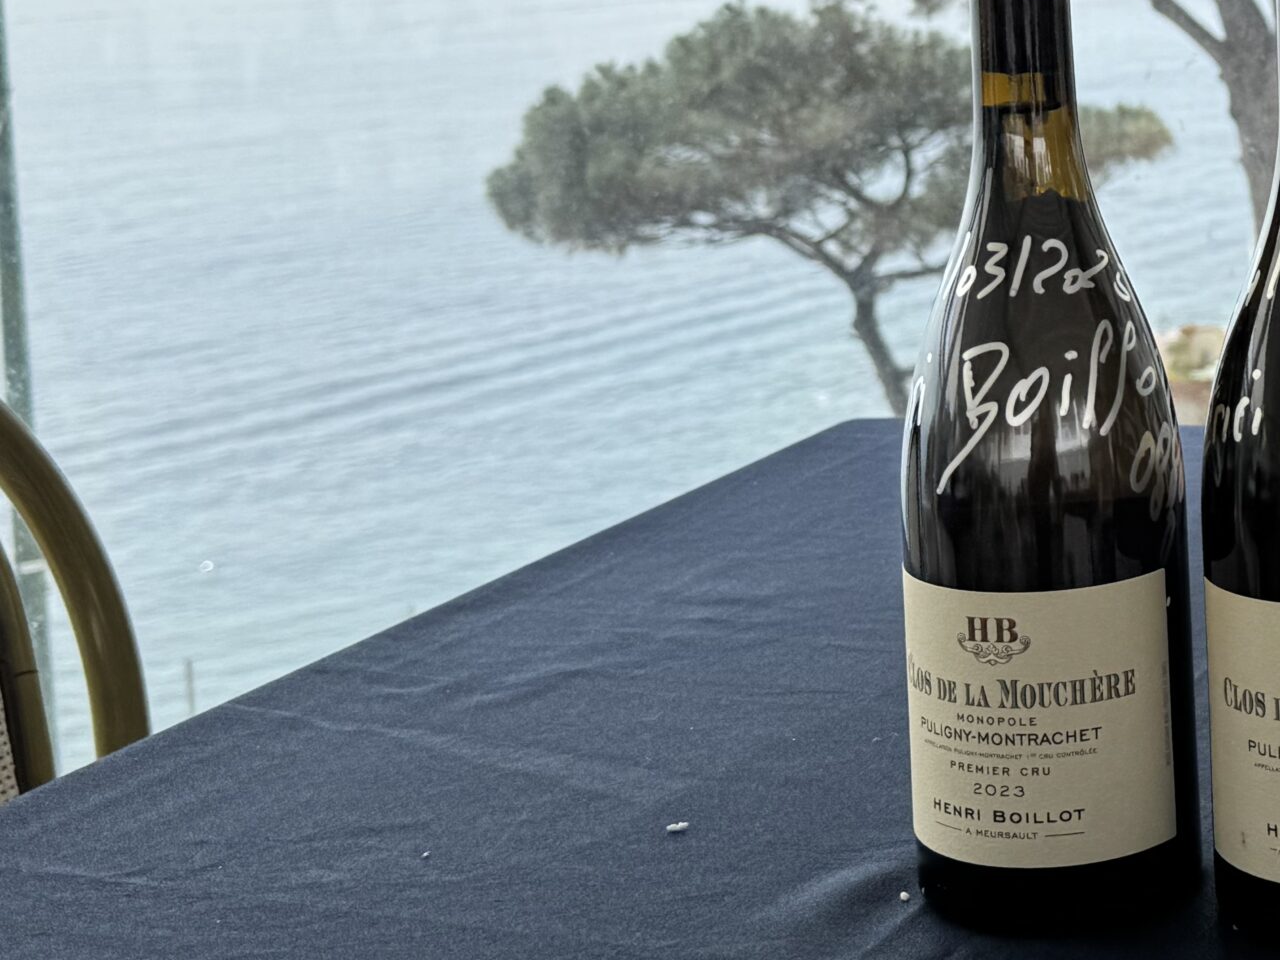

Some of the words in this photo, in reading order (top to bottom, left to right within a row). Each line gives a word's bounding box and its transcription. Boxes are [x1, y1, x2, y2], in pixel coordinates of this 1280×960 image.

[965, 616, 1018, 644] HB
[937, 677, 957, 704] DE
[964, 683, 991, 708] LA
[1223, 677, 1266, 718] CLOS
[921, 716, 1102, 747] PULIGNY-MONTRACHET
[957, 713, 1037, 727] MONOPOLE
[950, 761, 1011, 777] PREMIER
[1020, 765, 1051, 777] CRU
[973, 783, 1025, 798] 2023
[933, 797, 981, 821] HENRI
[993, 809, 1085, 824] BOILLOT
[965, 828, 972, 836] A
[976, 830, 1039, 840] MEURSAULT
